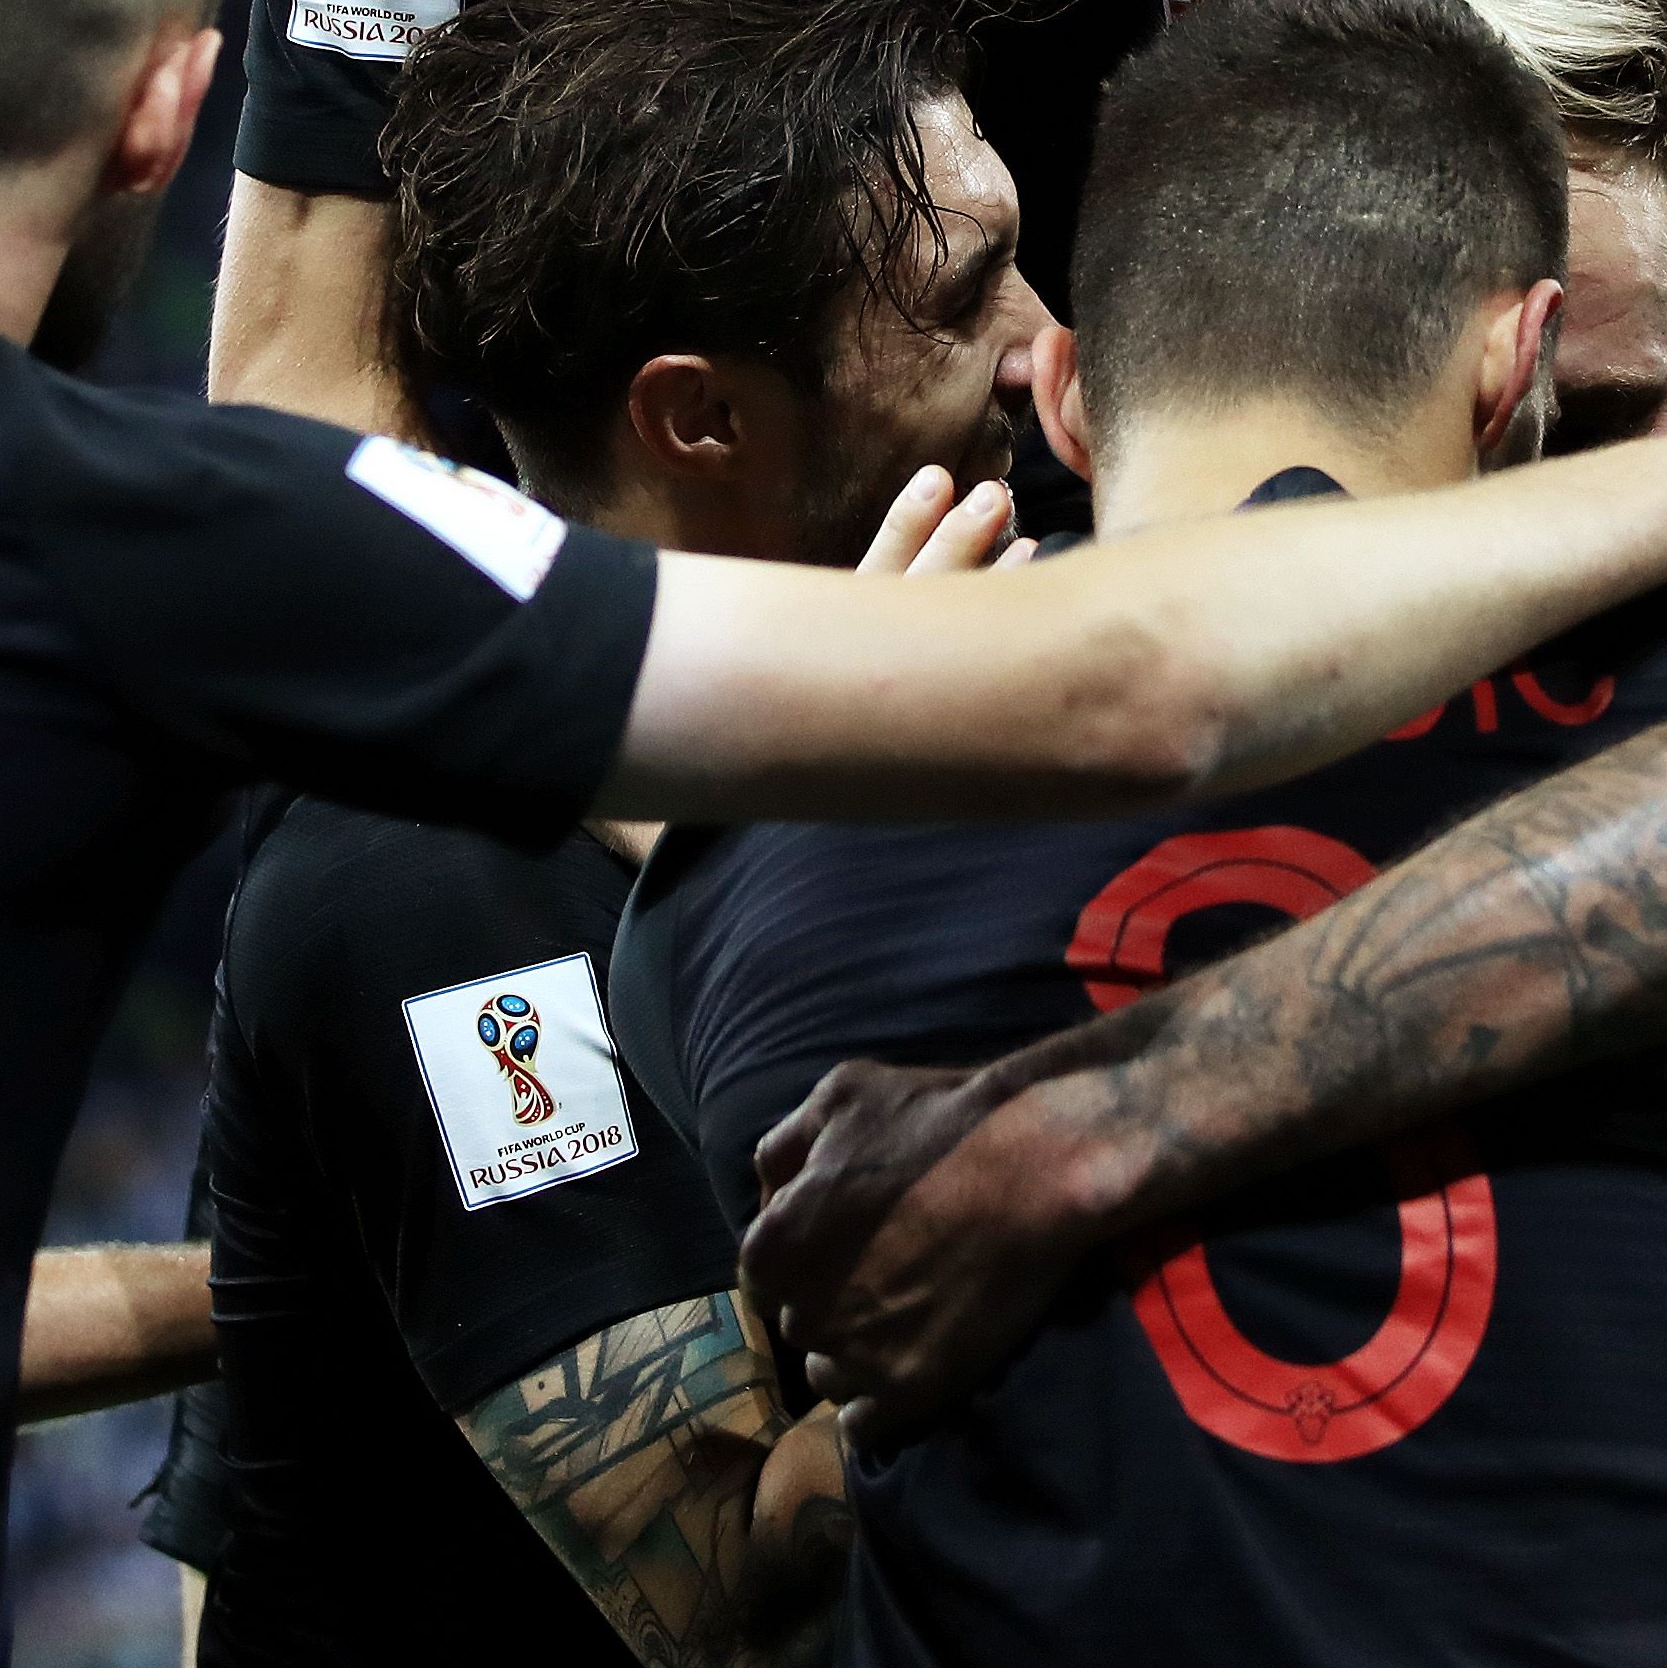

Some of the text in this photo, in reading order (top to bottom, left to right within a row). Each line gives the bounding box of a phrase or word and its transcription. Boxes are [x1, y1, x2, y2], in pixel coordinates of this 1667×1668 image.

[304, 8, 424, 45] RUSSIA 20
[326, 3, 416, 23] FIFA WORLD CUP
[469, 1125, 623, 1189] RUSSIA 2018
[497, 1122, 586, 1158] FIFA WORLD CUP
